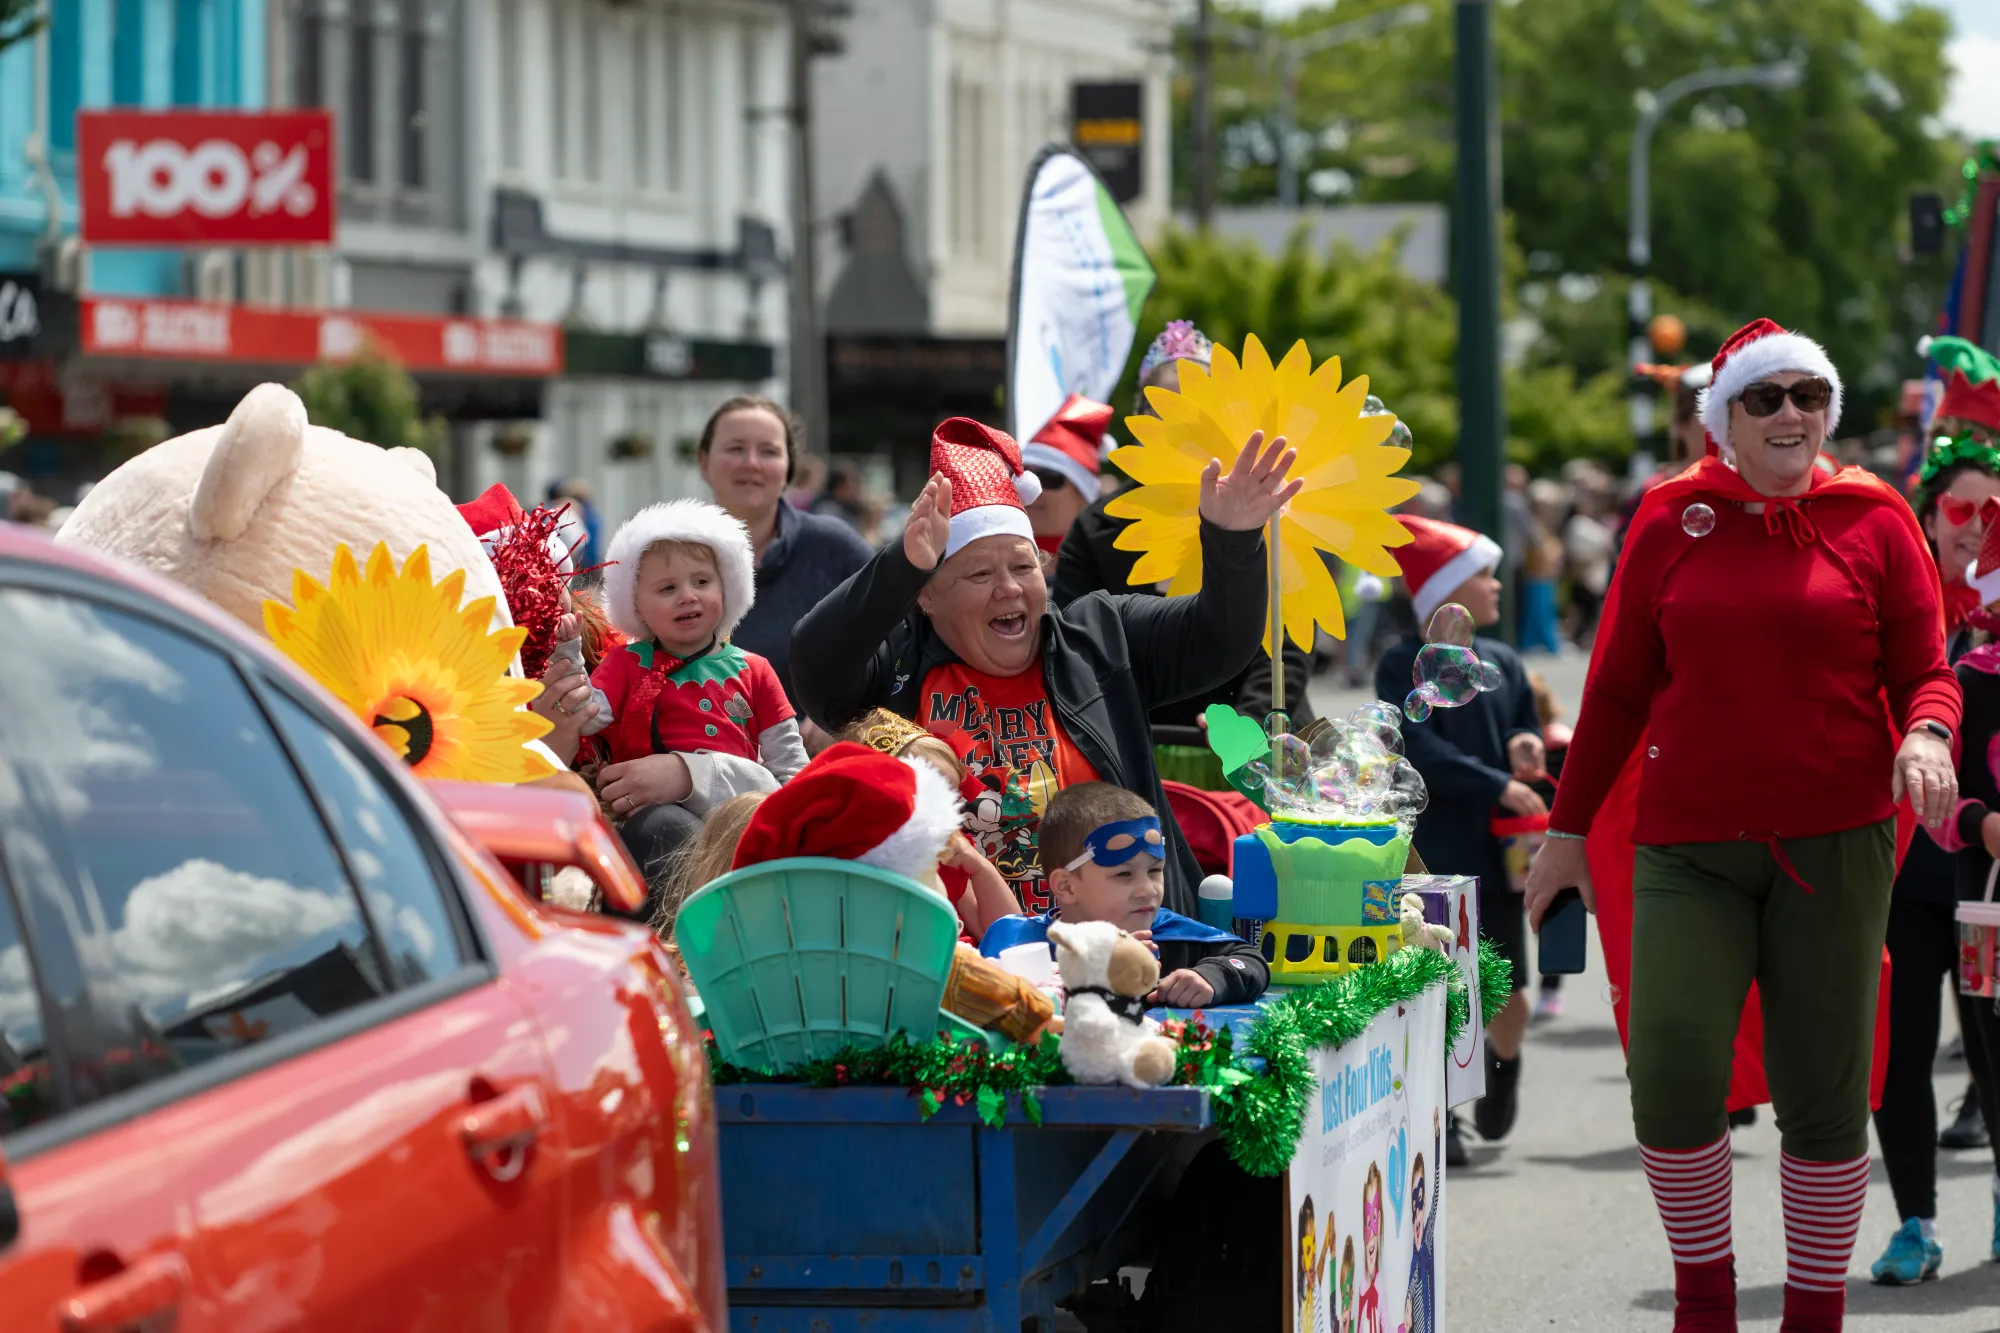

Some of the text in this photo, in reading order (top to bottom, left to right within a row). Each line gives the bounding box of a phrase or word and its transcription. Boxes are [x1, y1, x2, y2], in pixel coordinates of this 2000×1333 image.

[104, 138, 318, 219] 100%
[1321, 1041, 1392, 1136] Just Four Kids
